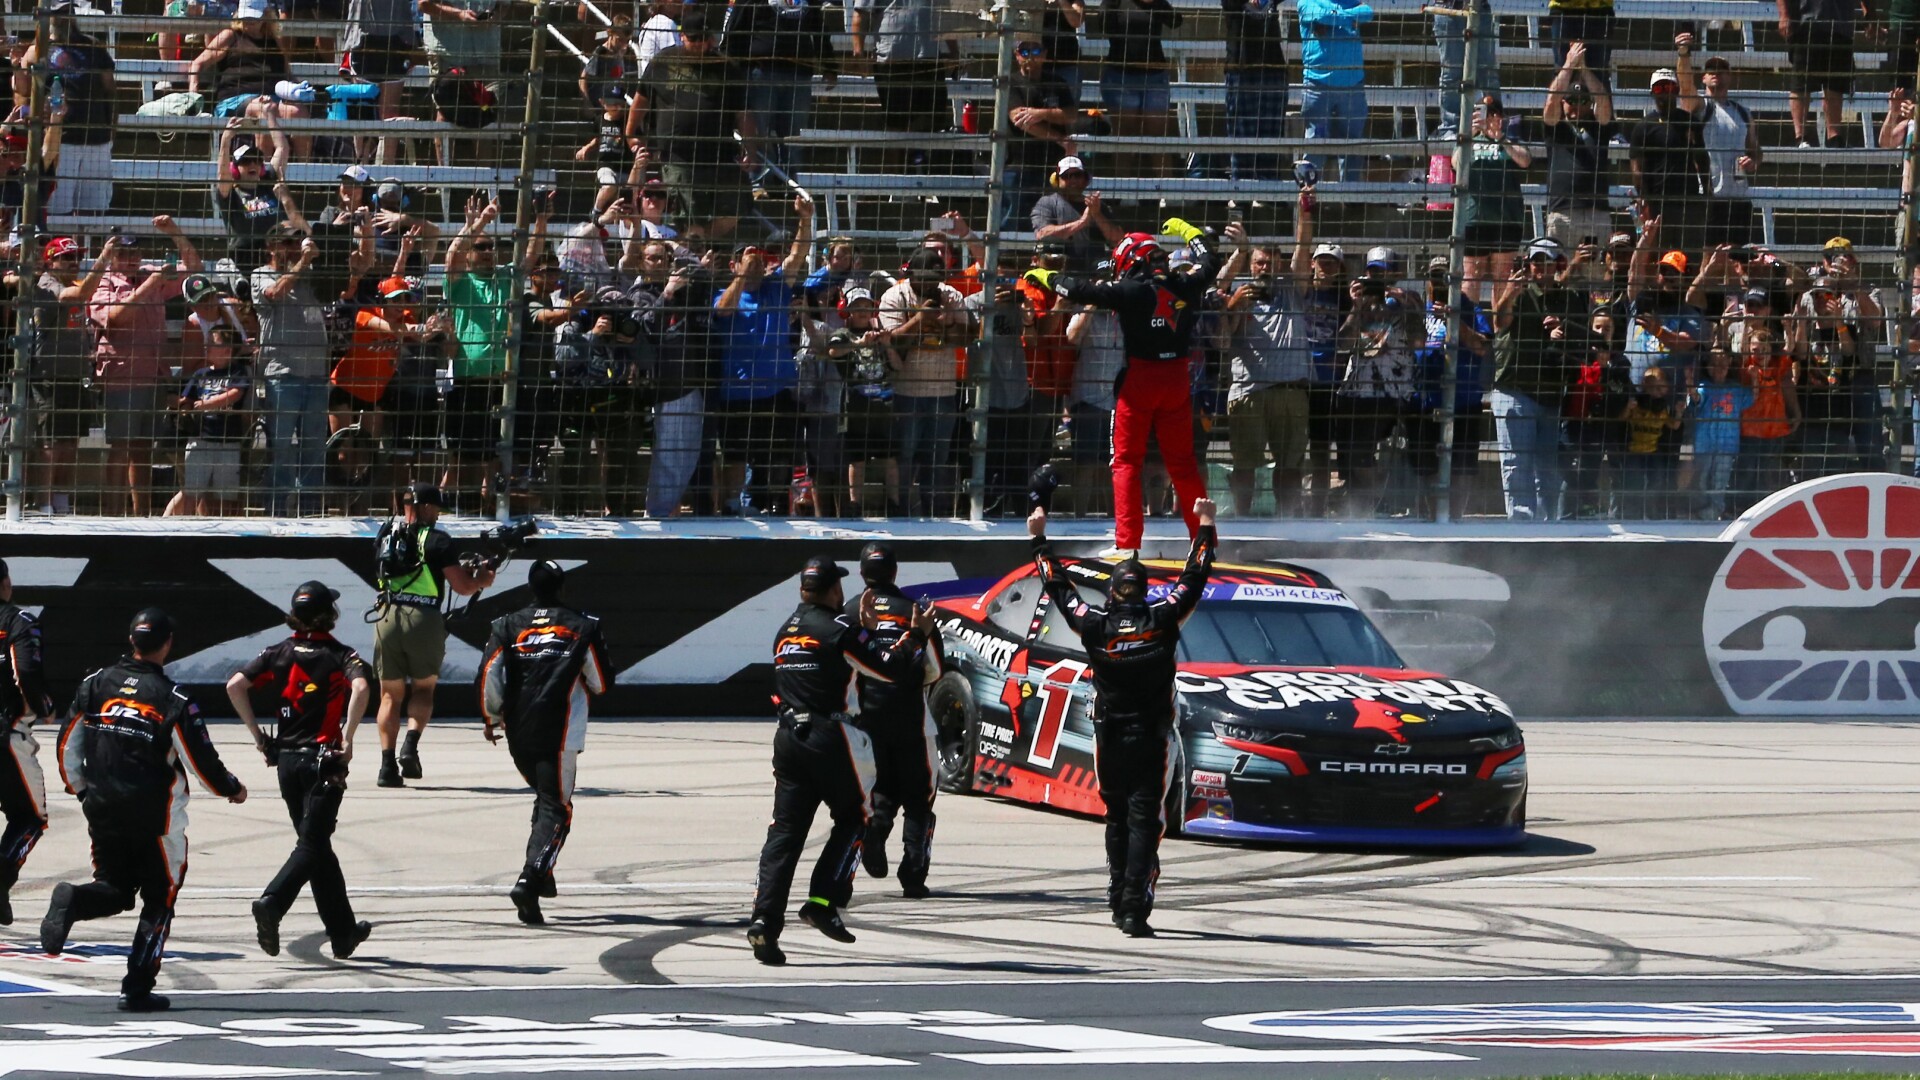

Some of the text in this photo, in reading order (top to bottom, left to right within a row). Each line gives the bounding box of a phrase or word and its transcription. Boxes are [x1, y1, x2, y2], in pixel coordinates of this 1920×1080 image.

[1151, 318, 1164, 327] CCI
[1243, 586, 1341, 602] DASH 4 CASH
[1174, 671, 1499, 699] CAROLINA
[1226, 684, 1514, 716] CARPORTS
[1028, 659, 1089, 769] 1
[980, 721, 1015, 744] TIRE PROS
[1230, 752, 1254, 775] 1
[1319, 760, 1467, 775] CAMARO
[1195, 774, 1223, 785] SIMPSON
[1191, 786, 1231, 799] ARP
